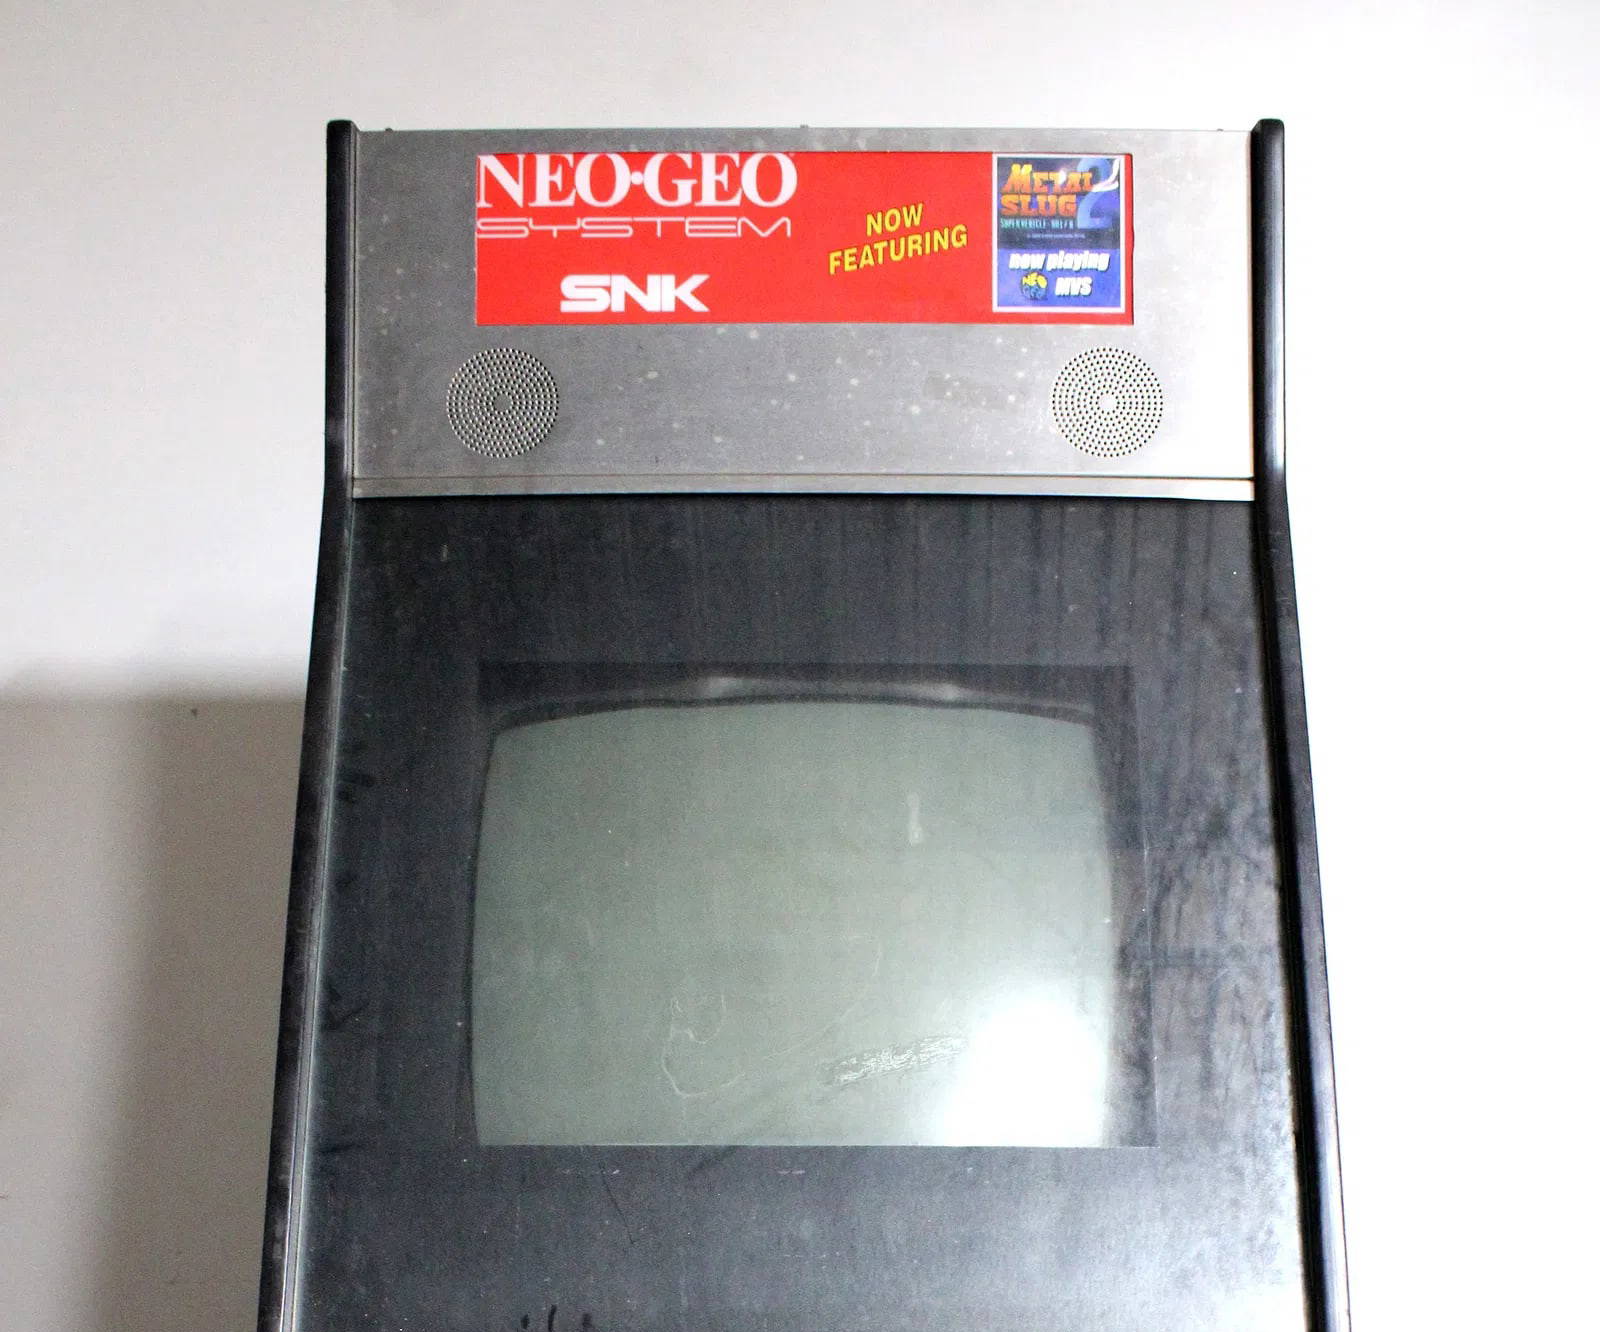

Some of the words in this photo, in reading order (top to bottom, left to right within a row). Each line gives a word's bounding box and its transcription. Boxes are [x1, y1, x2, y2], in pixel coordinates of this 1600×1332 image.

[1000, 194, 1077, 217] SLUG
[476, 217, 792, 239] SYSTEM
[865, 202, 925, 237] NOW
[828, 223, 968, 275] FEATURING
[1008, 253, 1046, 270] now
[1046, 250, 1111, 272] playing
[560, 274, 711, 313] SNK
[1055, 276, 1093, 296] MVS
